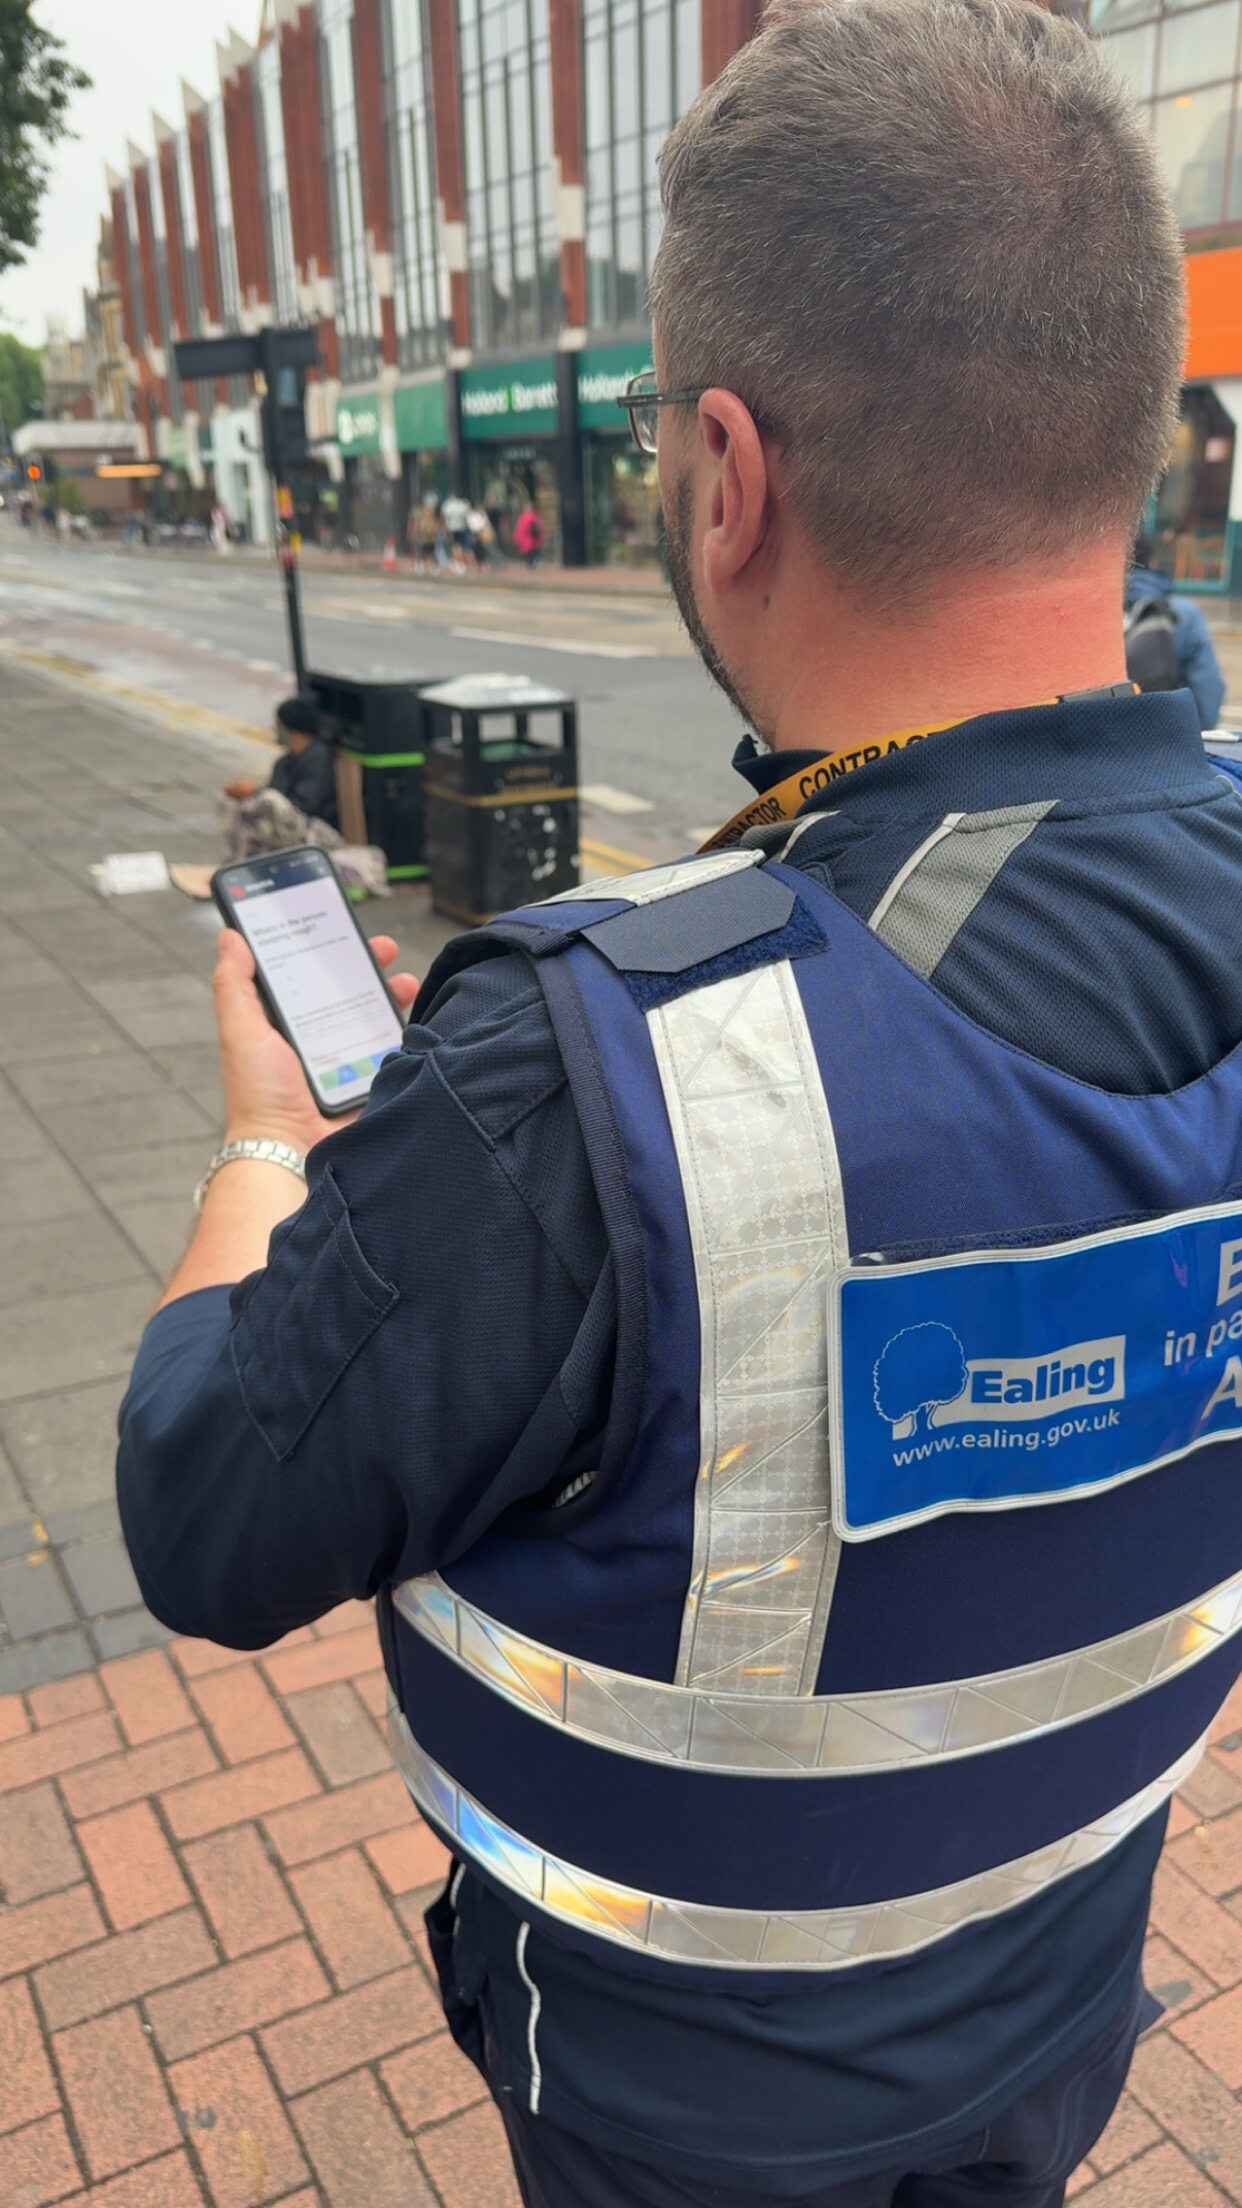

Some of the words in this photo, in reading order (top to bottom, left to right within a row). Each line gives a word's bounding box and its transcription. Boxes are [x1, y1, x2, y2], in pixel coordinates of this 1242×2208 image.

[1164, 1330, 1197, 1366] in
[970, 1356, 1115, 1405] Ealing
[892, 1408, 1121, 1468] www.ealing.gov.uk
